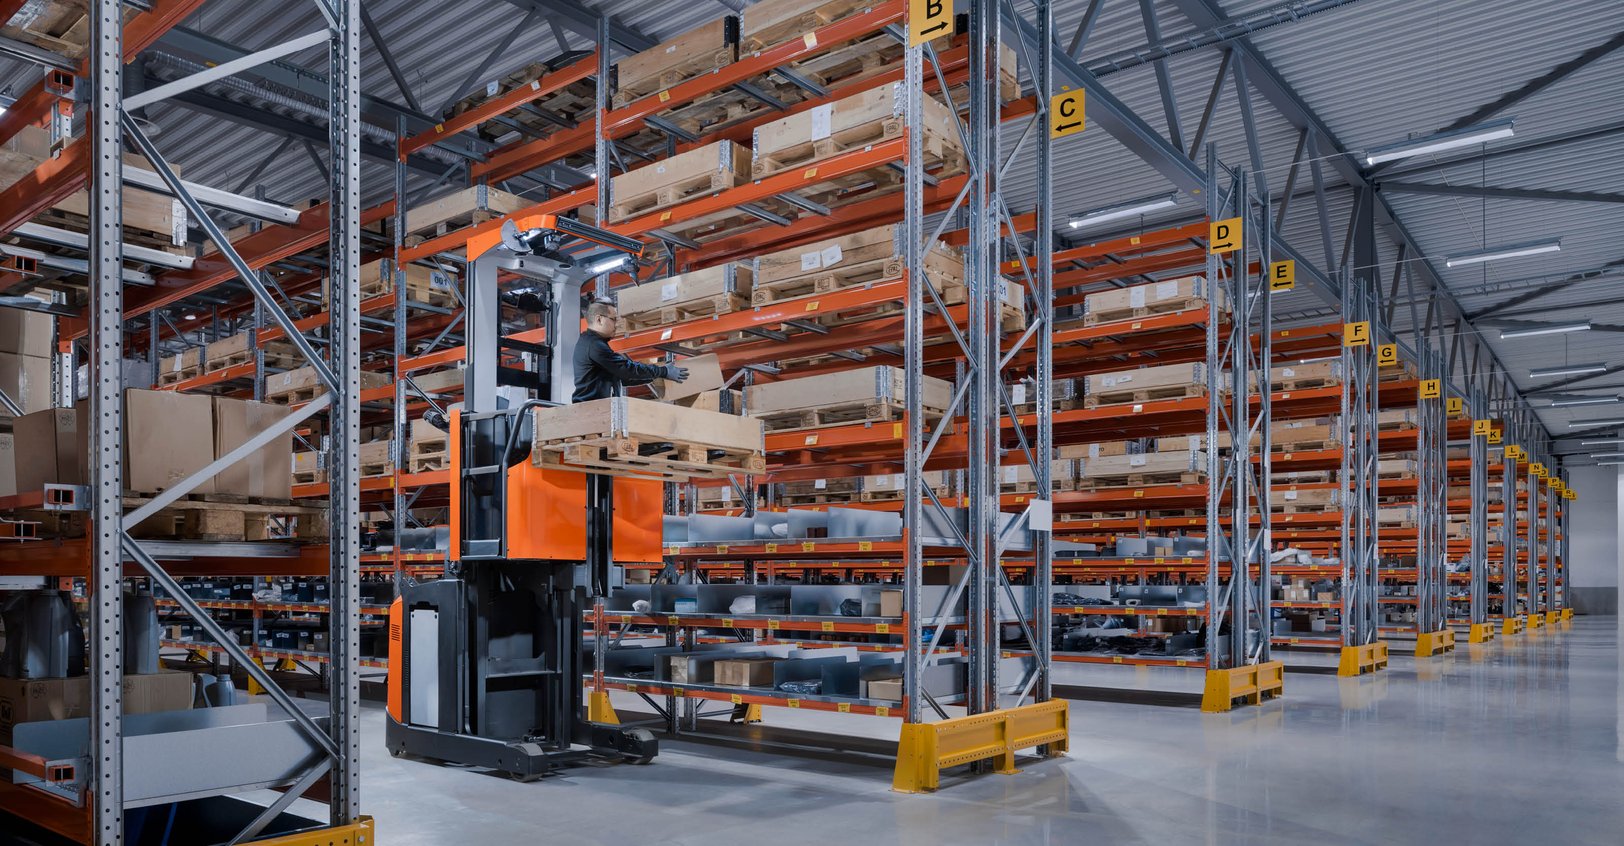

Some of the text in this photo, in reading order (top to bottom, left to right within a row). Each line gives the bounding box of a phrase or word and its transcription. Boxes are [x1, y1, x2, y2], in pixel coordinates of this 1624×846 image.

[926, 0, 943, 19] B
[1059, 97, 1076, 118] C
[1217, 224, 1230, 241] D
[1276, 264, 1287, 279] E
[1354, 324, 1363, 337] F
[1381, 347, 1392, 358] G
[1427, 381, 1436, 391] H
[1452, 400, 1456, 409] I
[1478, 421, 1485, 430] J
[1489, 431, 1497, 439] K
